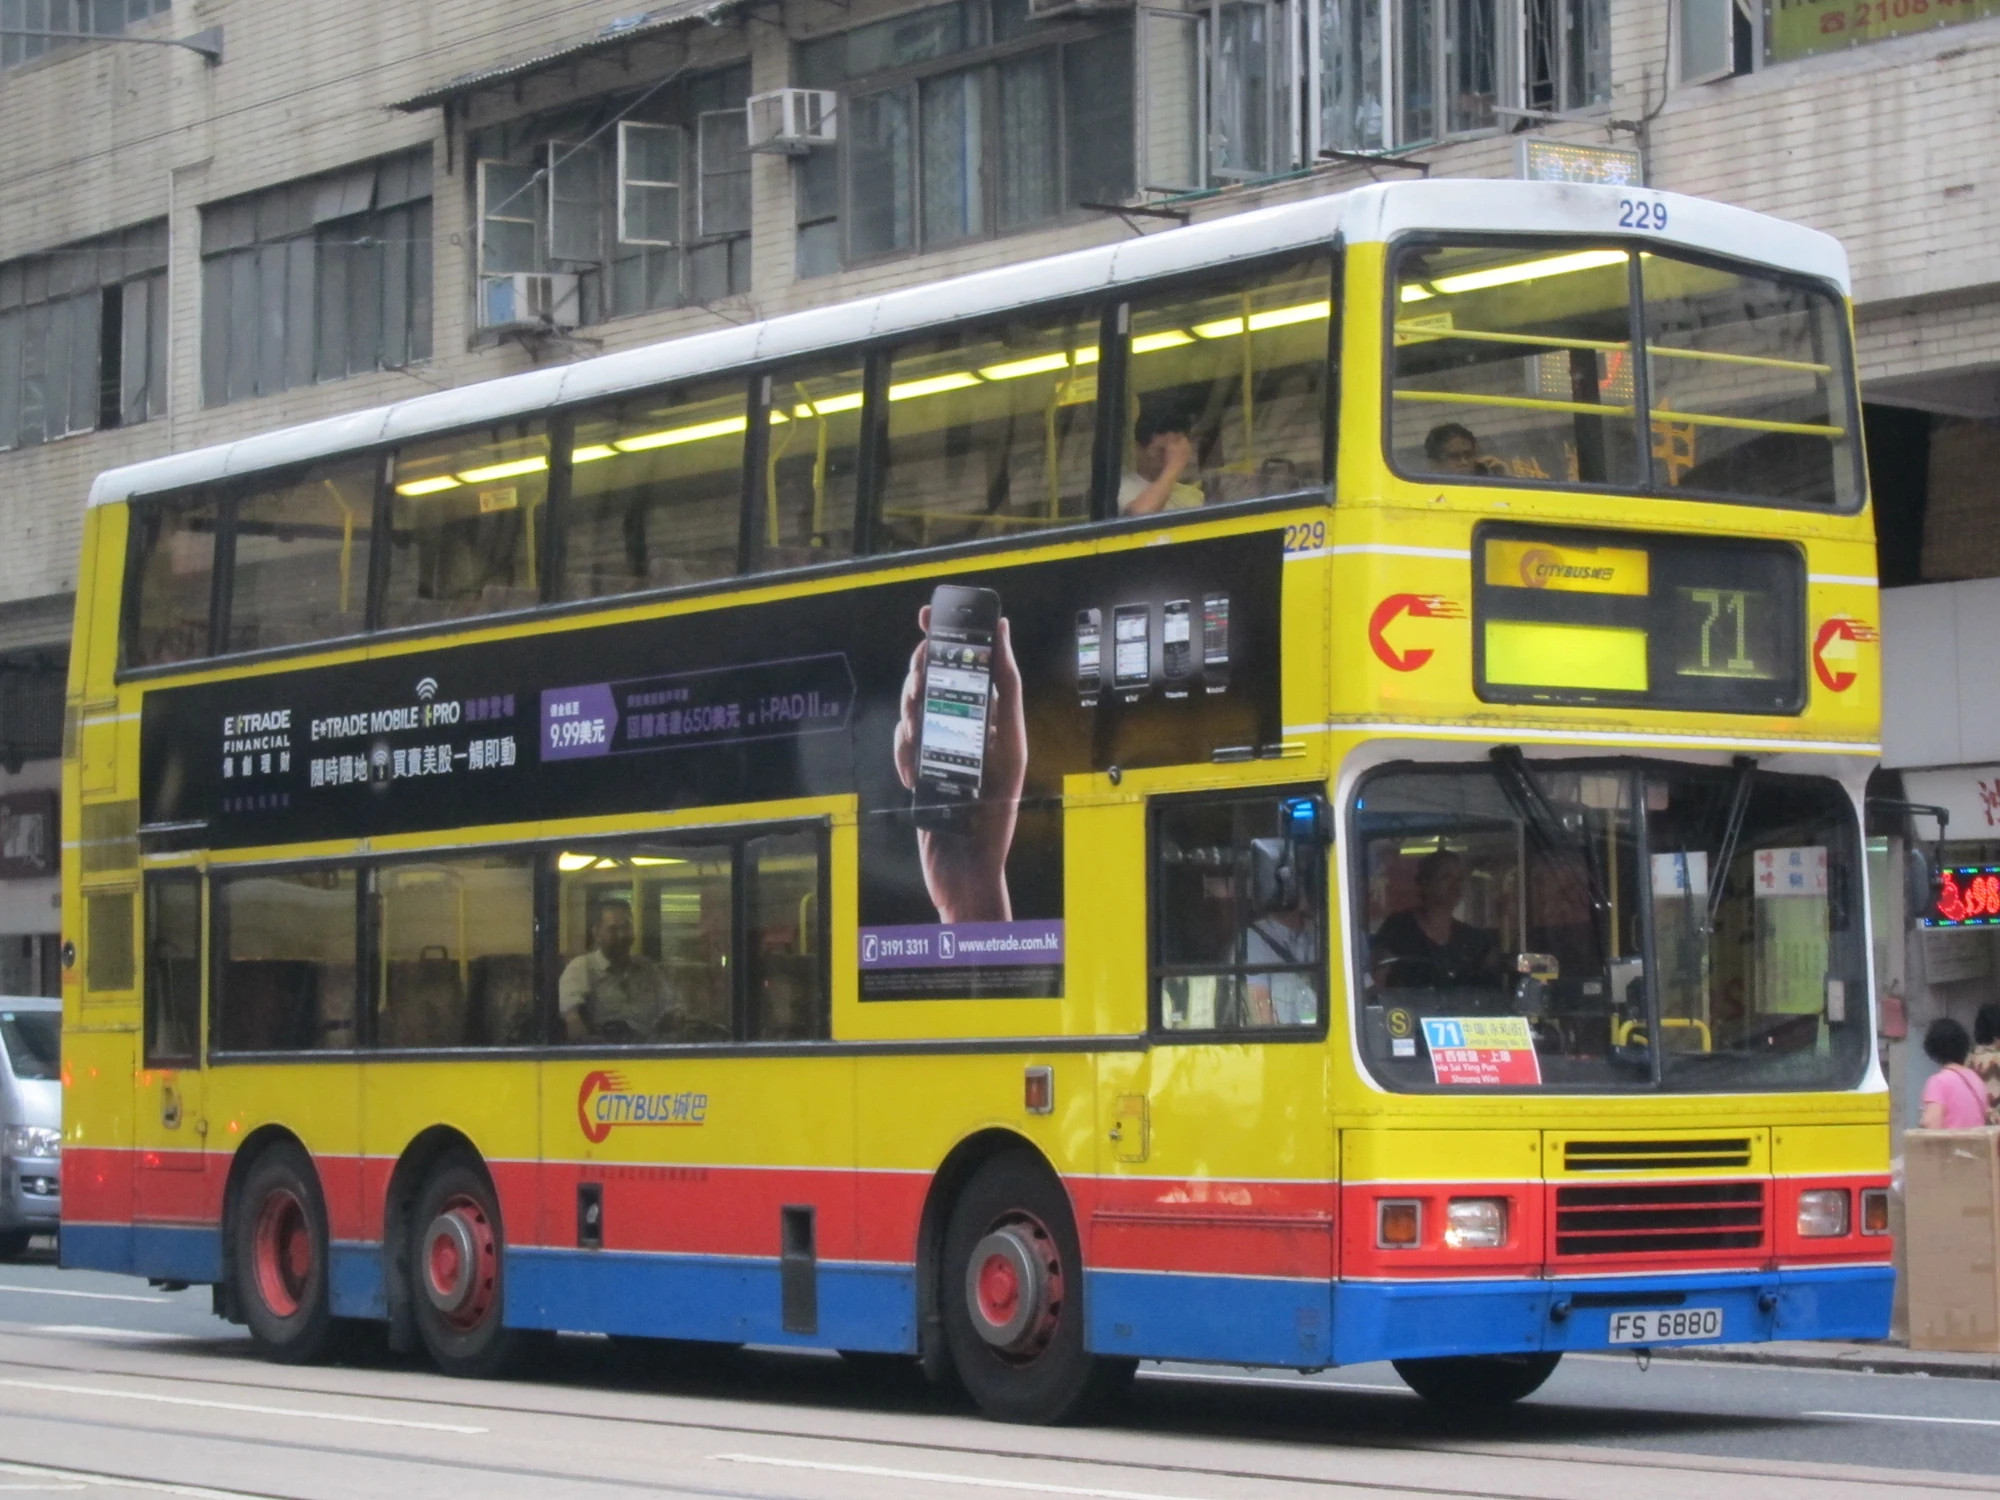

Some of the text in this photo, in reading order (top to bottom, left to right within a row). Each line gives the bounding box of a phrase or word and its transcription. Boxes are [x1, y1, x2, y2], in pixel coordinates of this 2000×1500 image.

[1618, 199, 1668, 231] 229
[1283, 520, 1326, 553] 229
[1535, 563, 1591, 580] CITYBUS
[1691, 588, 1754, 670] 71
[370, 706, 419, 733] MOBILE
[223, 733, 291, 754] FINANCIAL
[550, 719, 605, 748] 9.99美元
[881, 933, 1059, 956] 3191 3311 www.etrade.com.hk
[1391, 1012, 1406, 1034] S
[1431, 1022, 1460, 1046] 71
[1462, 1063, 1480, 1073] Ying
[596, 1091, 708, 1122] CITYBUS 城巴
[1615, 1310, 1718, 1340] FS 6880
